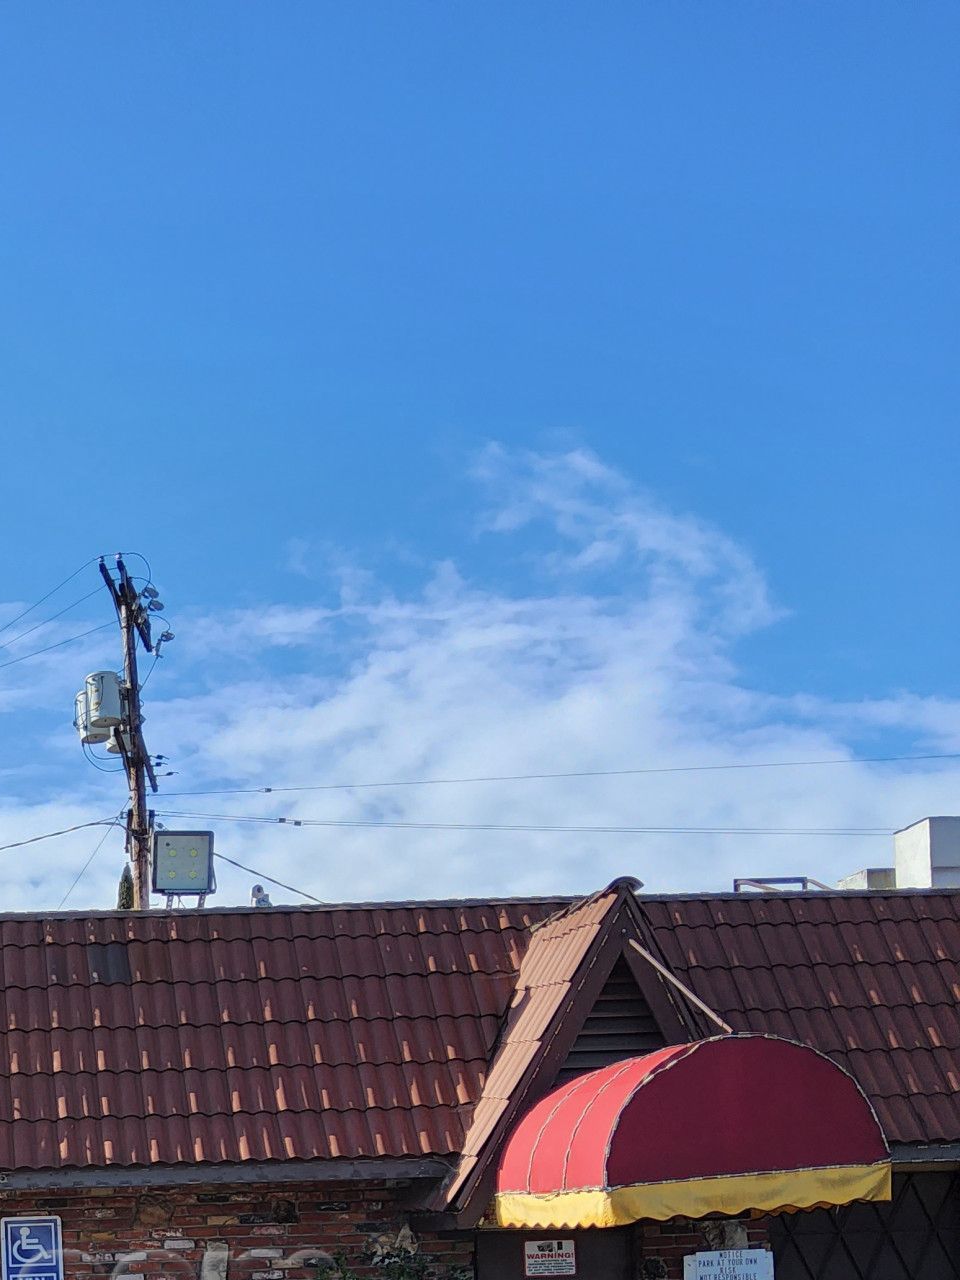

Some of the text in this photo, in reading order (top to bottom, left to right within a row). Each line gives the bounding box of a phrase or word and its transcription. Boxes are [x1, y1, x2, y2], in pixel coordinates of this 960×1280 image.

[720, 1251, 743, 1259] NOTICE
[698, 1257, 758, 1268] PARK AT YOUR OWN
[714, 1273, 757, 1280] RESPONSIBLE
